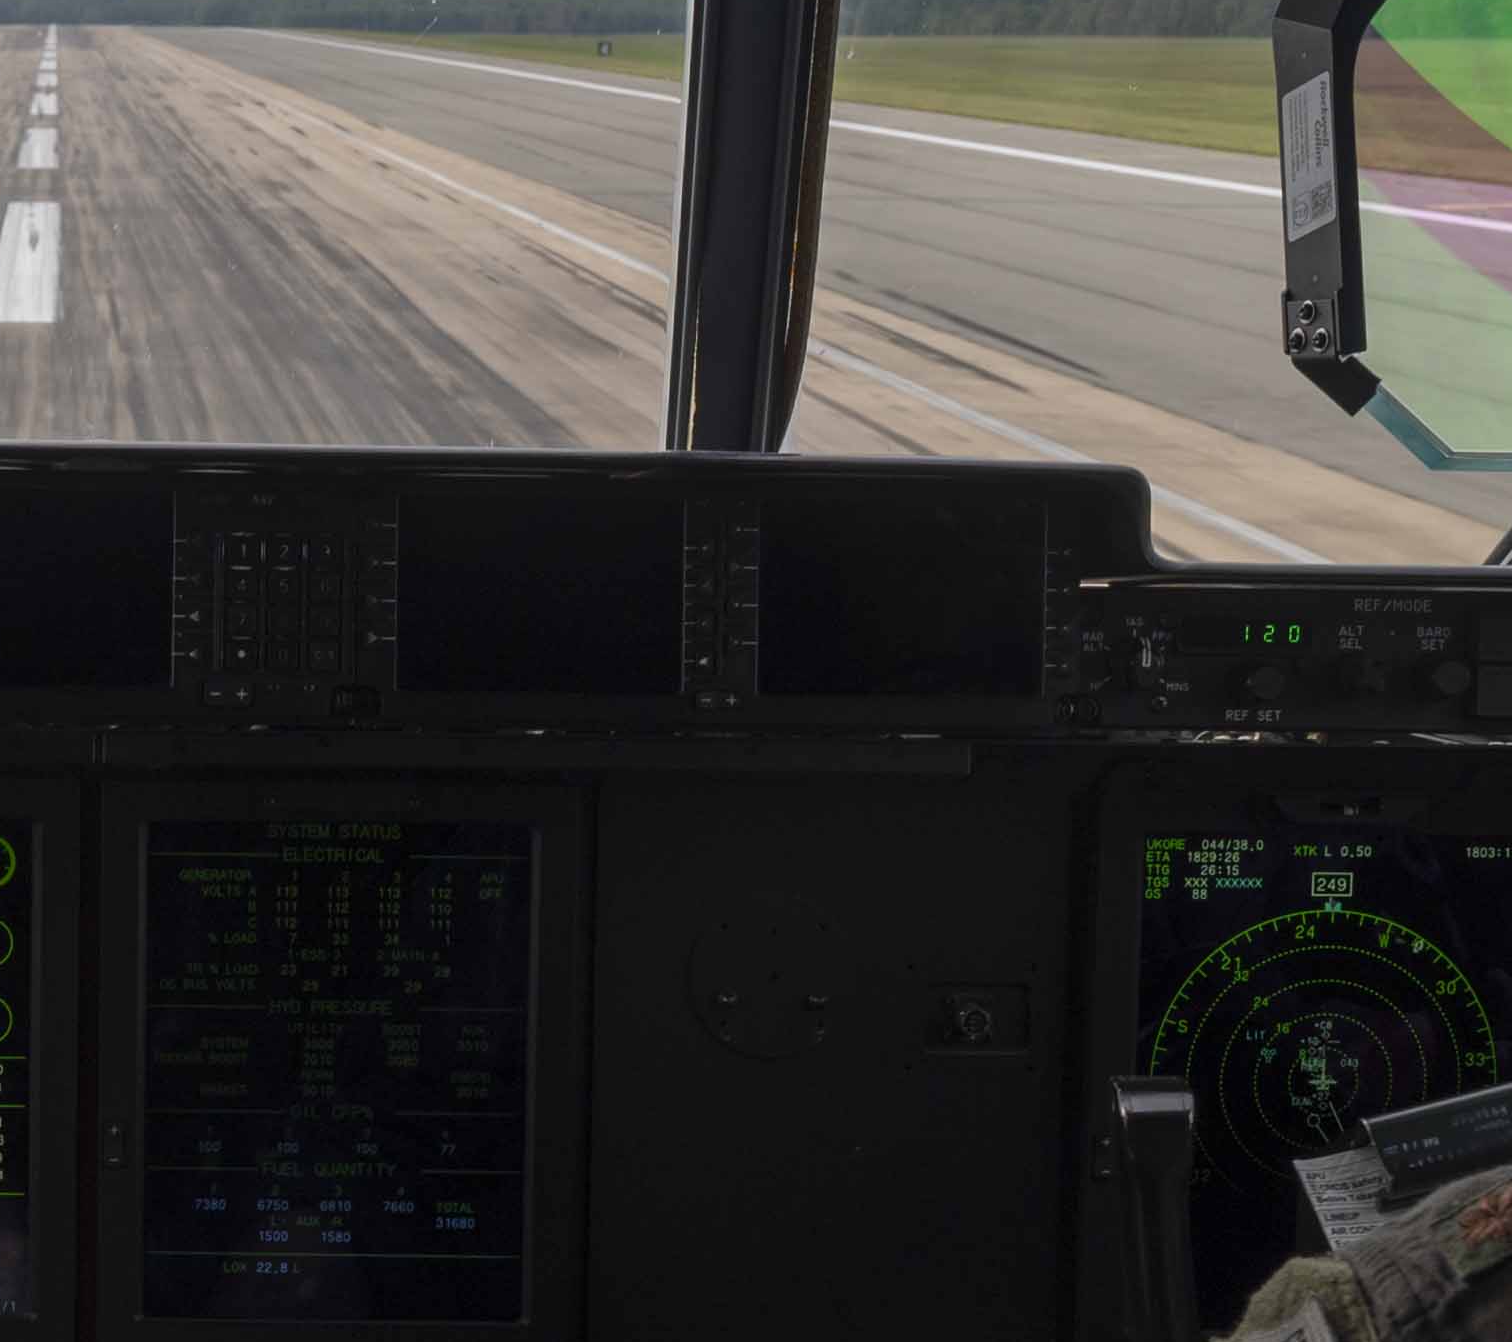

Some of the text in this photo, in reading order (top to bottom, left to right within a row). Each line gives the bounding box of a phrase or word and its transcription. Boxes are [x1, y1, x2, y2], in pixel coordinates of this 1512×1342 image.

[1354, 599, 1432, 612] REF/MODE
[1339, 626, 1363, 636] ALT
[1339, 639, 1363, 649] SEL
[1226, 711, 1281, 721] REF SET
[1294, 846, 1372, 857] XTK 0.50
[1188, 852, 1240, 863] 1829:26
[1201, 865, 1239, 875] 26:15
[1317, 879, 1346, 892] 249
